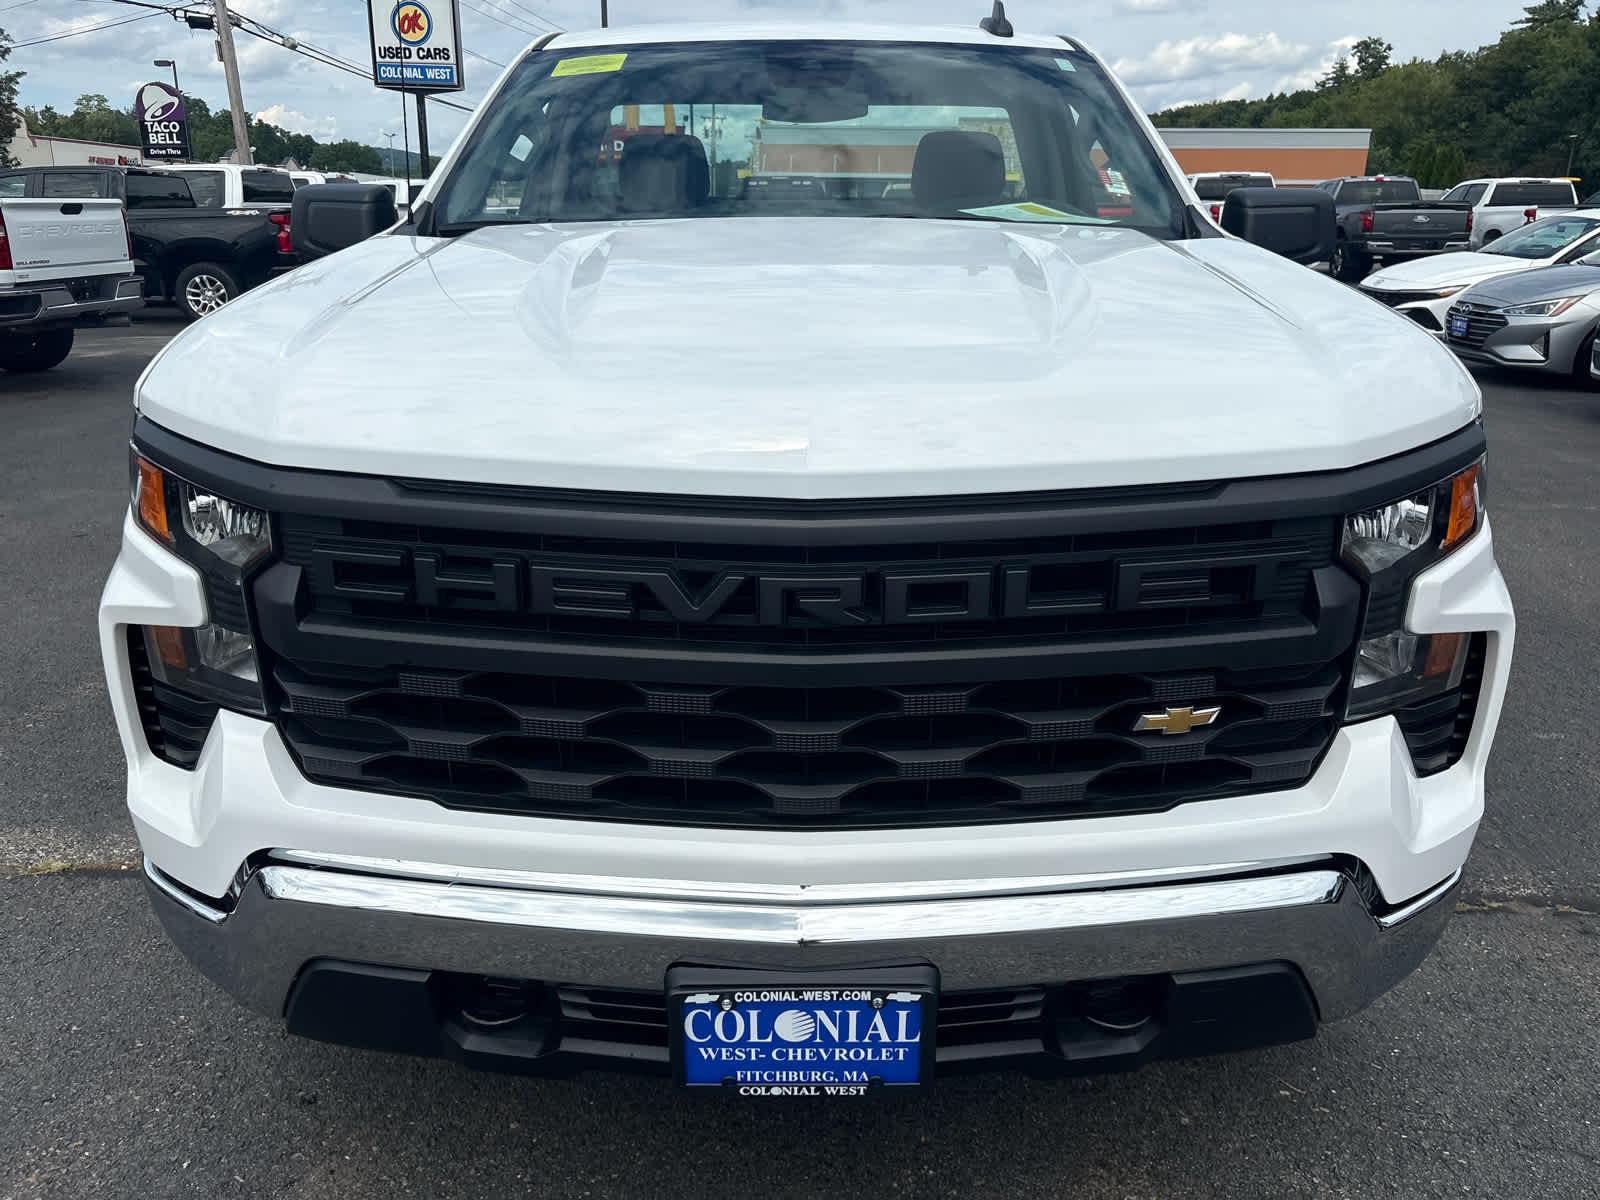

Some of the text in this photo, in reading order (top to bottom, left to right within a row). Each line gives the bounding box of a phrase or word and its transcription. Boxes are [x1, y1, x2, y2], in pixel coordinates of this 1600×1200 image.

[400, 9, 425, 34] OK
[378, 46, 450, 61] USED CARS
[425, 68, 451, 80] WEST
[144, 121, 180, 133] TACO
[148, 133, 181, 144] BELL
[310, 544, 1311, 626] CHEVROLET
[734, 991, 871, 1002] COLONIAL-WEST.COM
[684, 1009, 921, 1043] COLONIAL
[771, 1047, 909, 1061] CHEVROLET
[736, 1070, 870, 1083] FITCHBURG, MA
[739, 1086, 868, 1096] COLONIAL WEST
